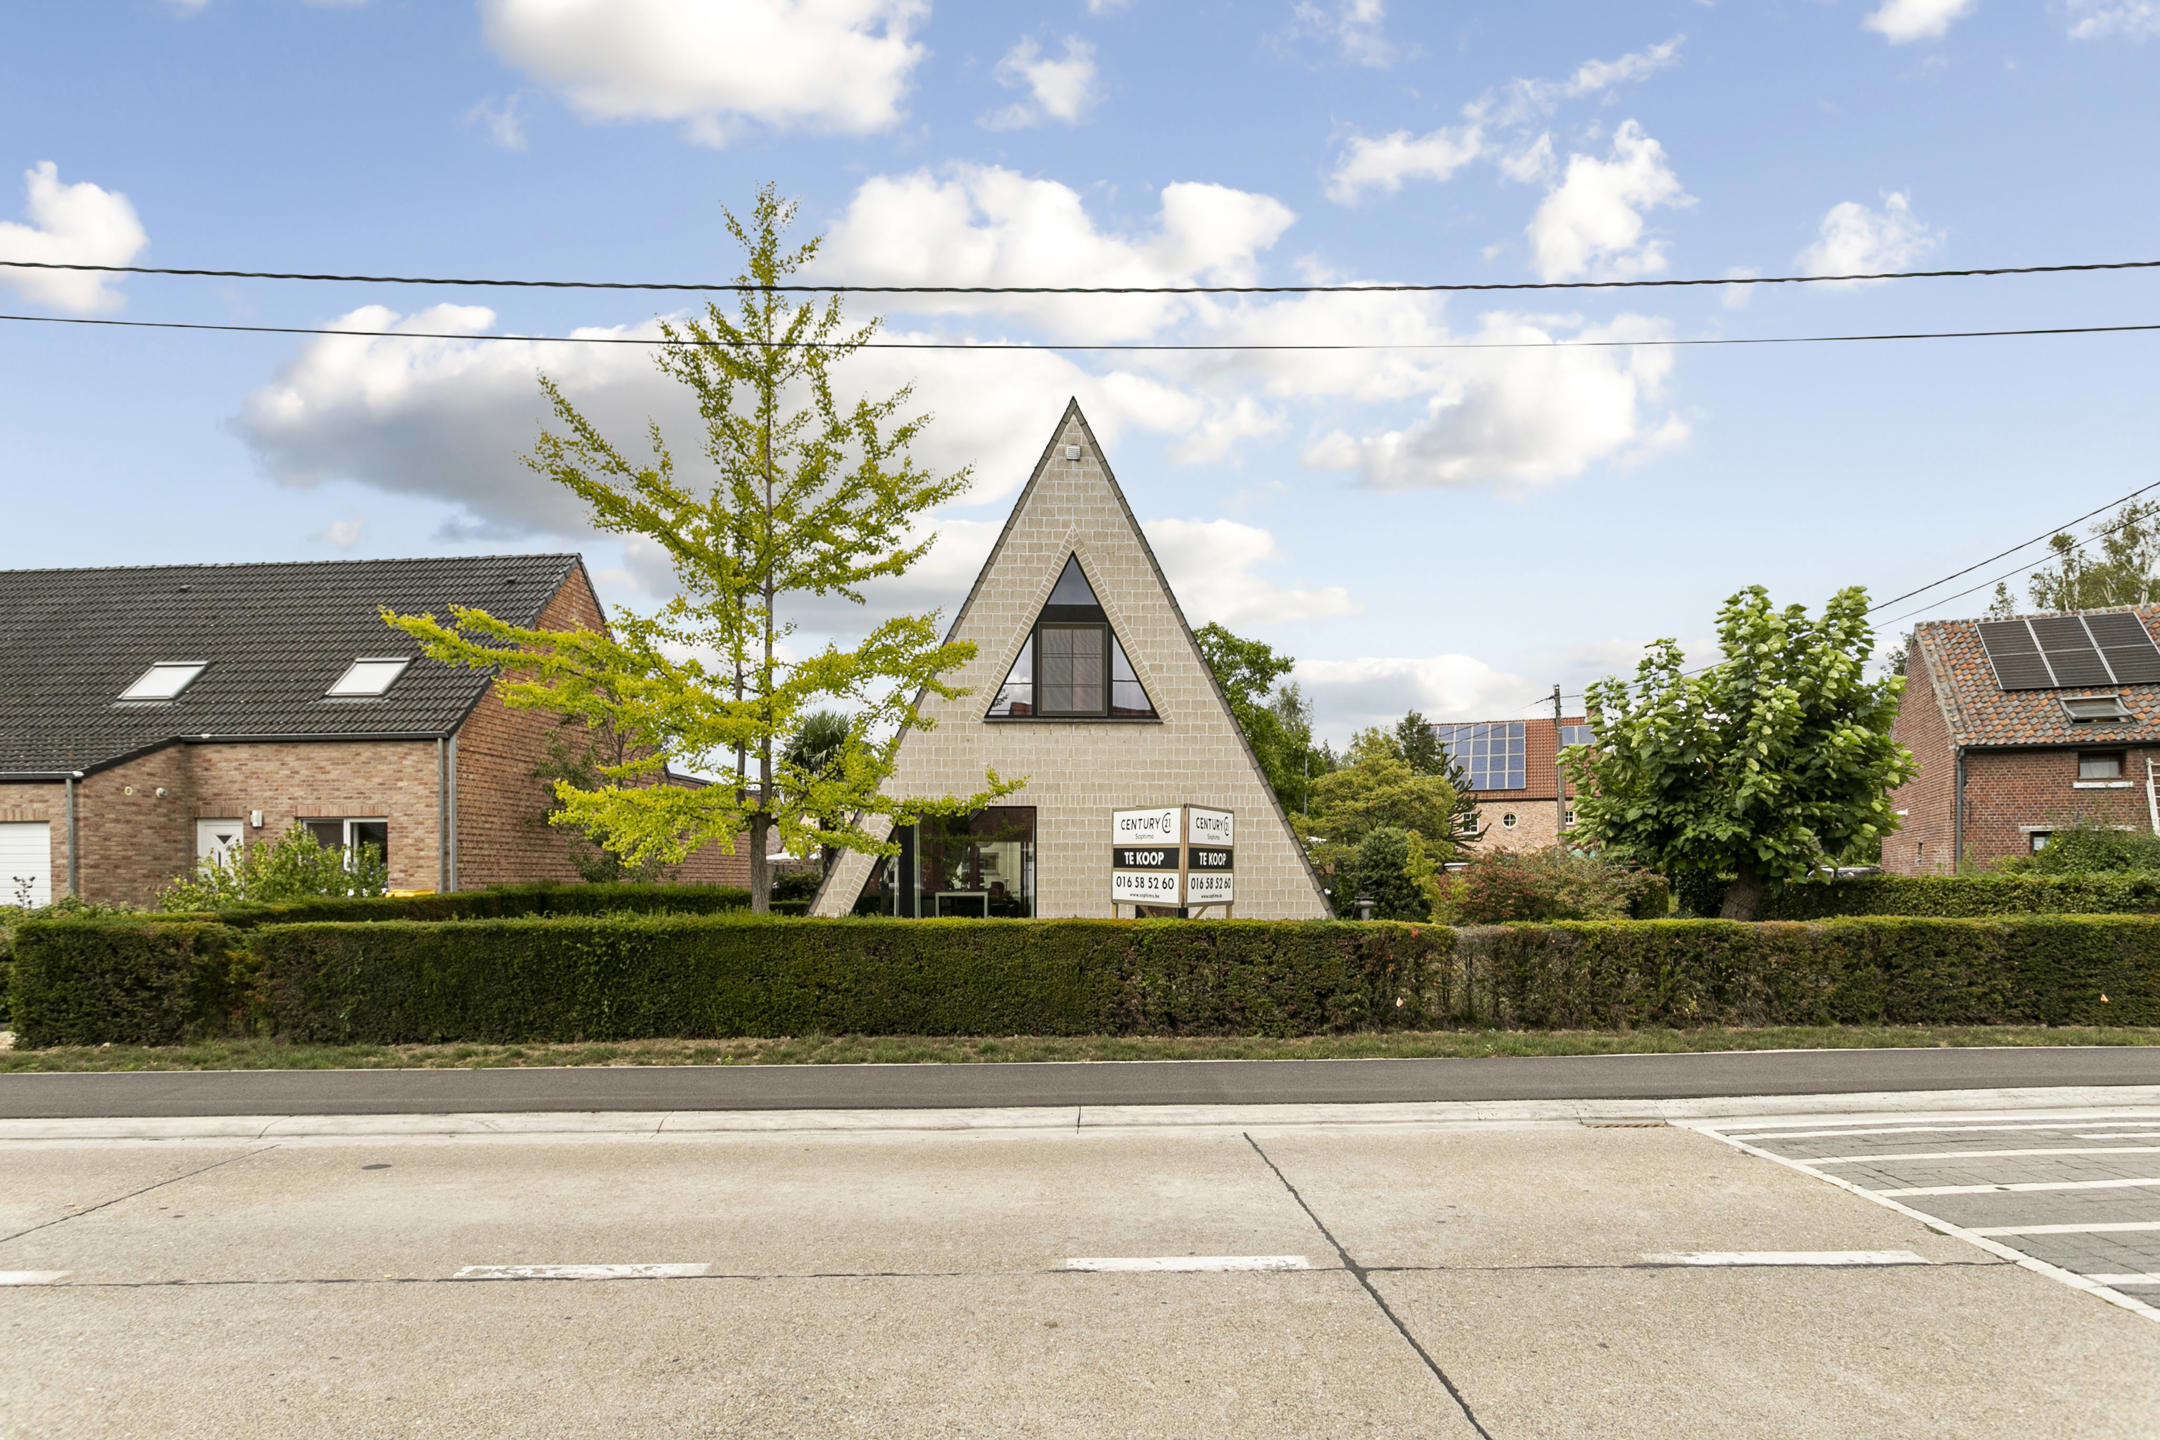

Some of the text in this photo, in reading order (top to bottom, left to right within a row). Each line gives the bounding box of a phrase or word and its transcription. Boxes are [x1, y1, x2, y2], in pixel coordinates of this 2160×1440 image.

[1121, 817, 1161, 830] CENTURY
[1196, 817, 1223, 831] CENTURY
[1124, 852, 1164, 865] TE KOOP
[1199, 852, 1227, 866] TE KOOP
[1116, 876, 1174, 890] 016 58 52 60
[1191, 877, 1231, 890] 016 58 52 60
